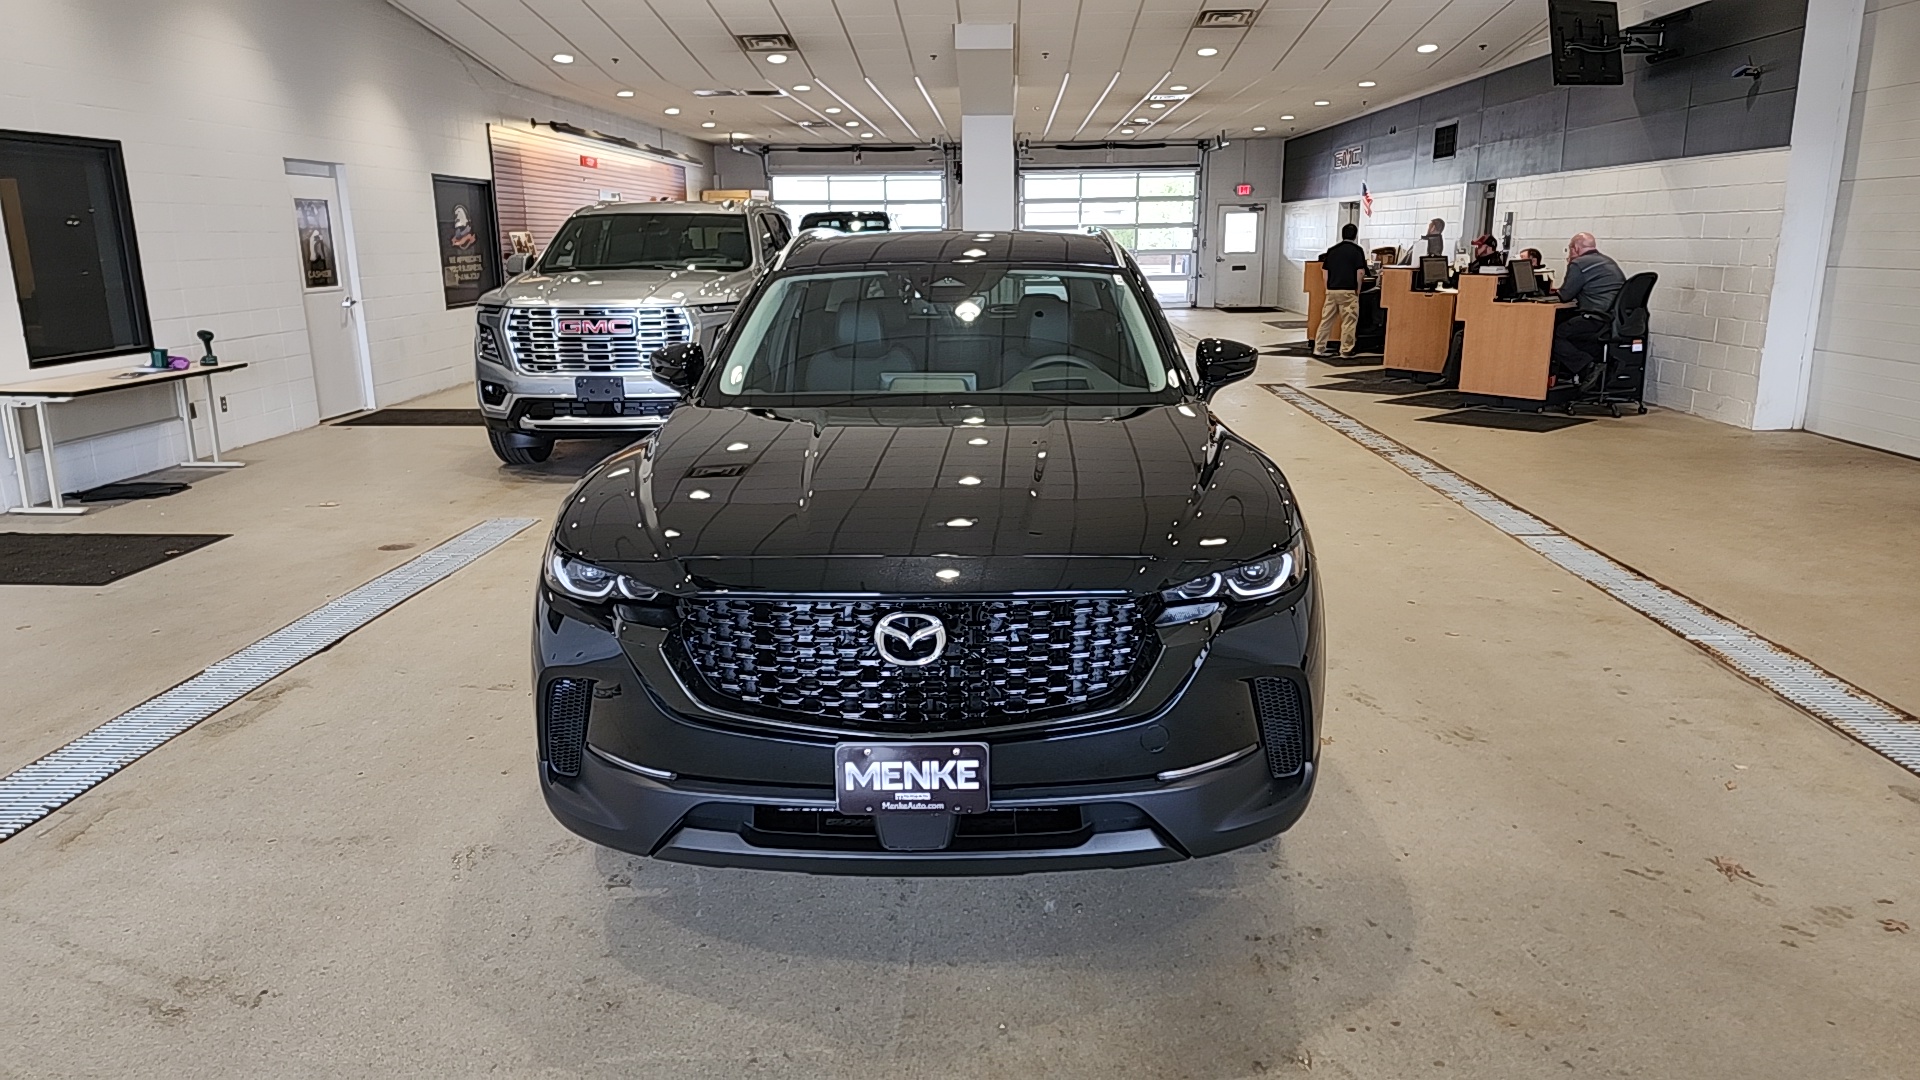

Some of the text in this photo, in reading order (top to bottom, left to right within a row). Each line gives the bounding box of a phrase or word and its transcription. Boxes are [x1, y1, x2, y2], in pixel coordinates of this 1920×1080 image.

[560, 319, 632, 334] GMC
[845, 760, 980, 791] MENKE
[882, 801, 945, 810] MenkeAuto.com
